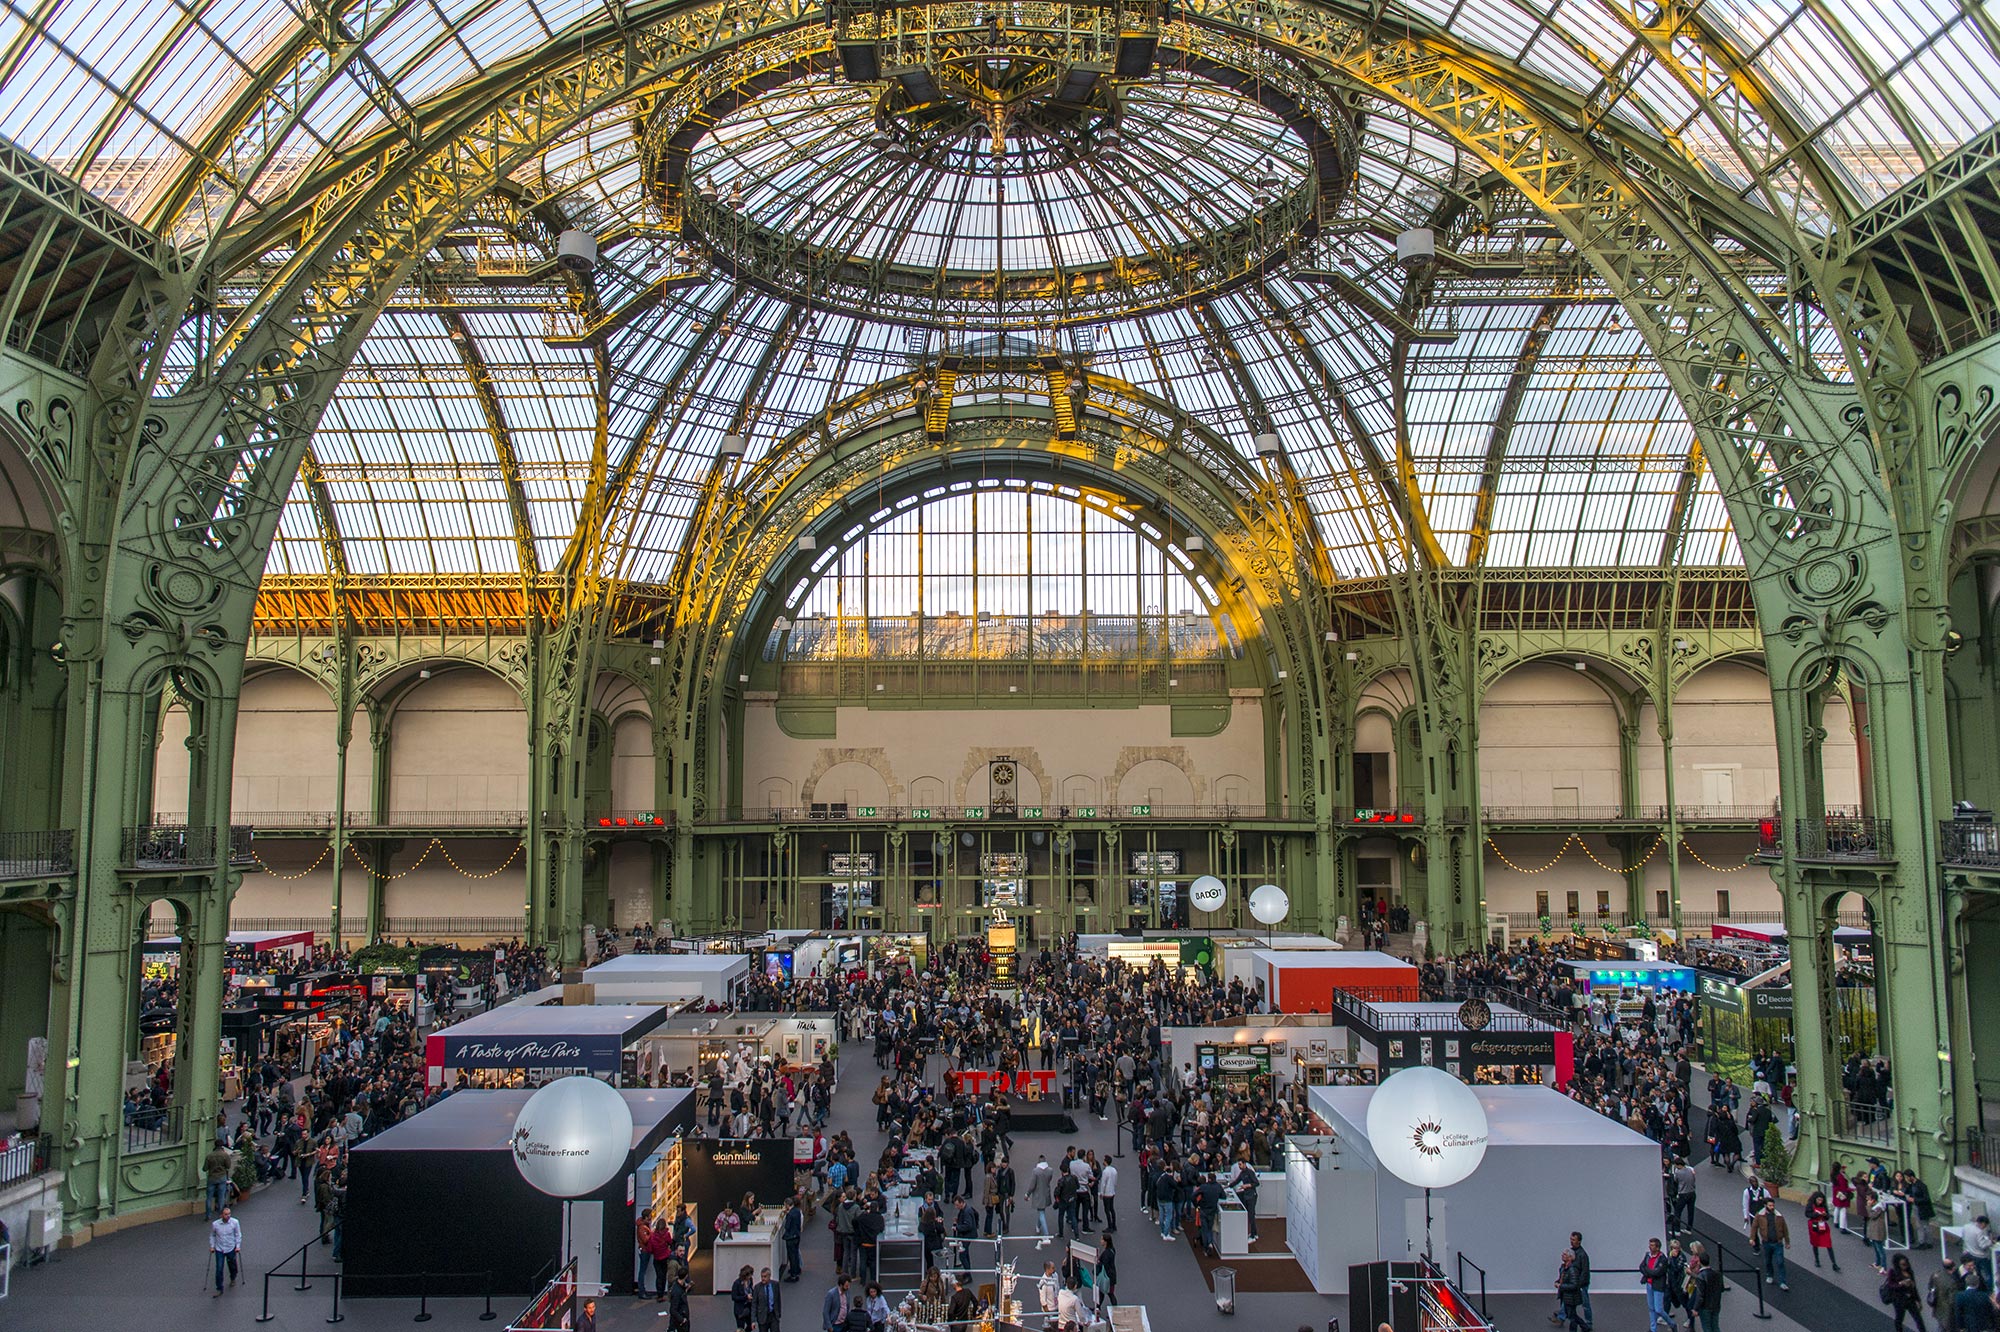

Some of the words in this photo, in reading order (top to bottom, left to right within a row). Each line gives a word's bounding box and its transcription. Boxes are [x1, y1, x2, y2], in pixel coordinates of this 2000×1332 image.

[455, 1045, 468, 1058] A
[470, 1042, 504, 1058] Taste
[504, 1046, 522, 1062] of
[520, 1042, 551, 1058] Ritz
[549, 1041, 581, 1058] Paris
[1471, 1040, 1552, 1056] @fsgeorgevparis
[1220, 1057, 1257, 1067] Cassegrain
[561, 1148, 590, 1157] France
[712, 1151, 734, 1161] alain
[735, 1149, 761, 1161] milliat
